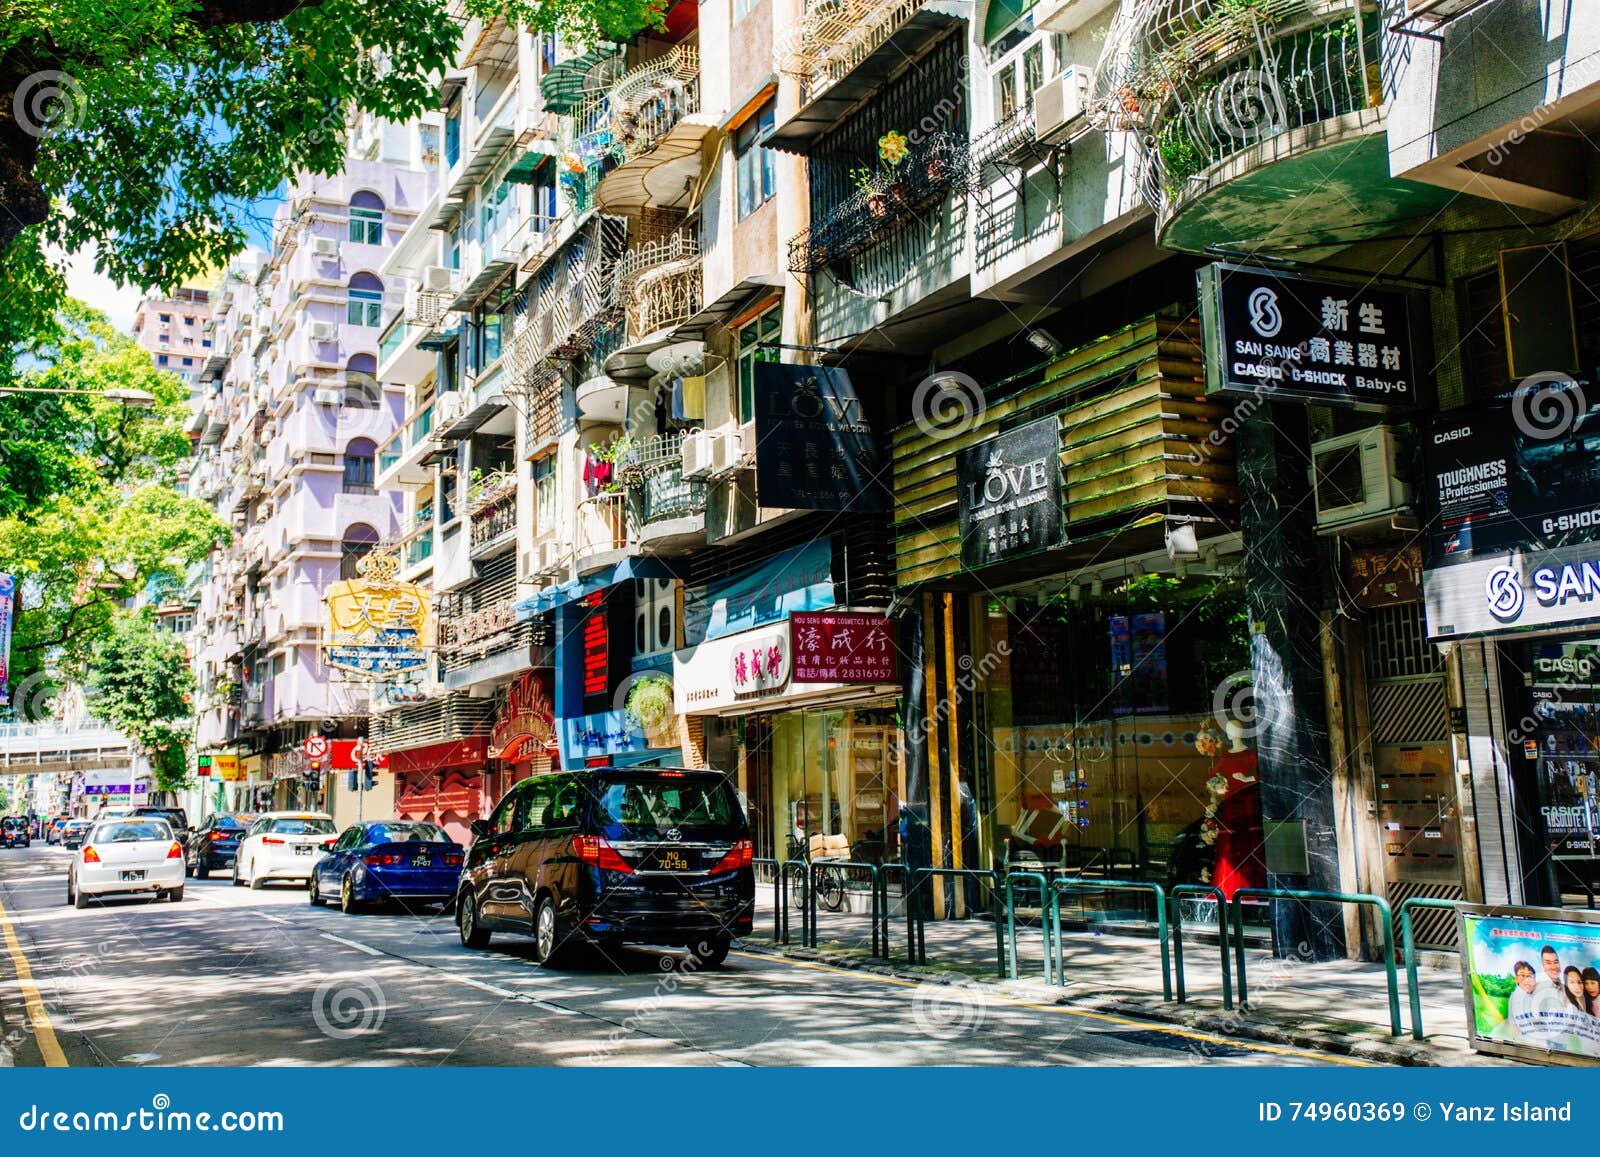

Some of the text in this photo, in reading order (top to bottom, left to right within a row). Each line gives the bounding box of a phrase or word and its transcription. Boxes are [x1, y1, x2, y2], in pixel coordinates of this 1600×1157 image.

[1321, 296, 1386, 335] 新生
[1235, 340, 1301, 360] SAN SANG
[1309, 336, 1401, 371] 商業器材
[1234, 362, 1283, 380] CASIO
[1292, 368, 1407, 394] G-SHOCK Baby-G
[1434, 426, 1471, 444] CASIO
[967, 458, 1048, 510] LOVE
[1437, 459, 1507, 489] TOUGHNESS
[1446, 477, 1508, 499] Professionals
[341, 594, 419, 630] 天皇
[842, 669, 892, 678] 28316957
[1540, 658, 1591, 673] CASIO
[1541, 806, 1581, 816] CASIO
[659, 860, 688, 869] 70-58
